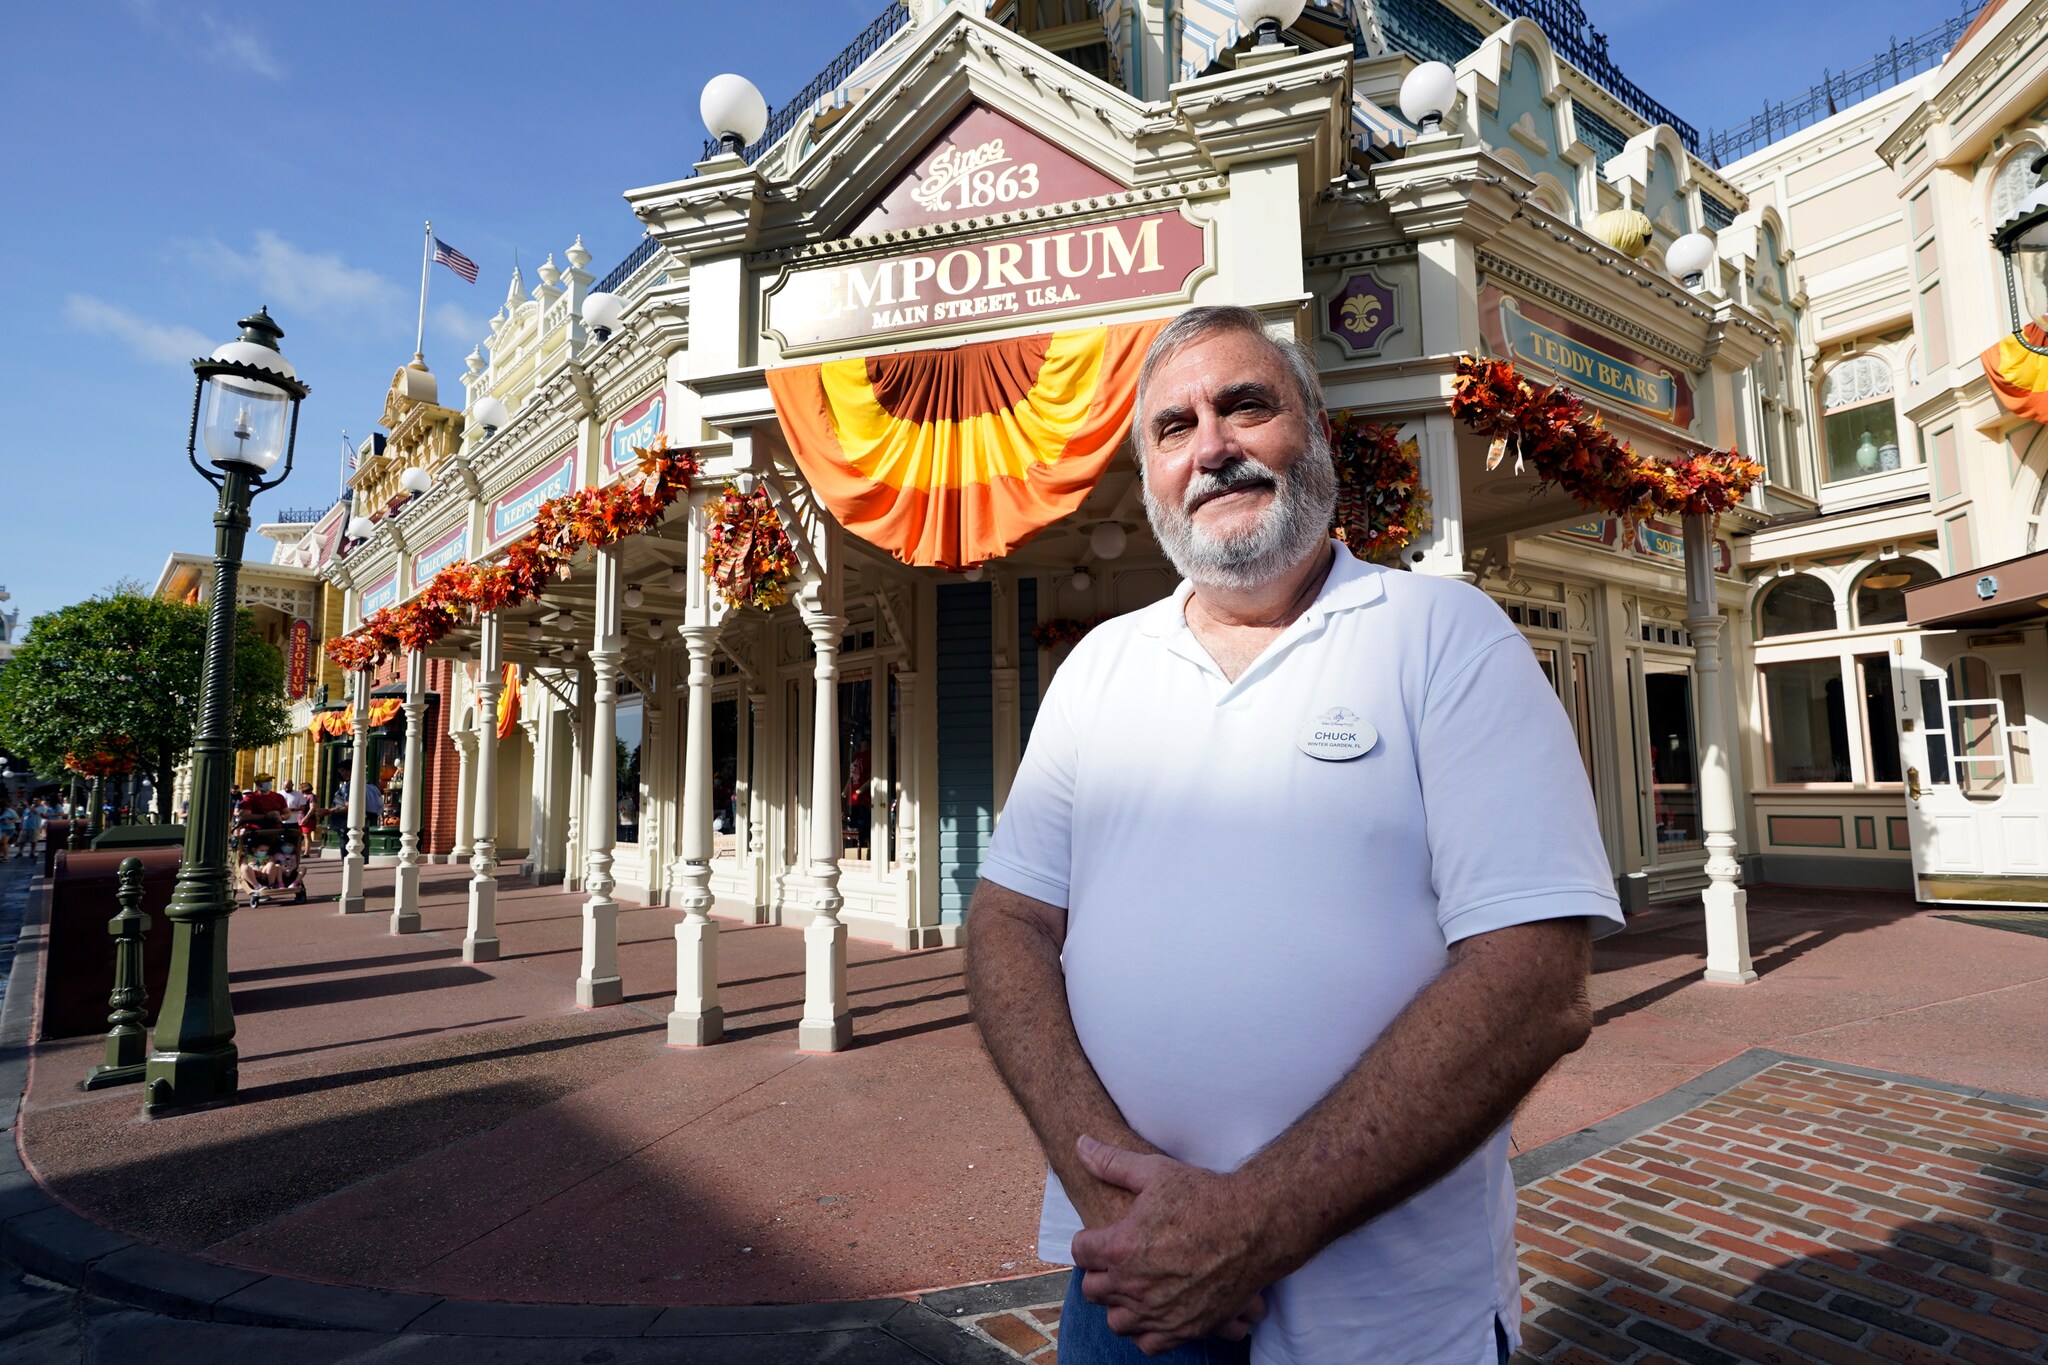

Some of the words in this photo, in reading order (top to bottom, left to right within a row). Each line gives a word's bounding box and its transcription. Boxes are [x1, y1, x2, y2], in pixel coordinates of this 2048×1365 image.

[913, 137, 1012, 192] Since
[956, 163, 1040, 210] 1863
[872, 303, 928, 329] MAIN
[934, 292, 1019, 322] STREET,
[1027, 283, 1081, 307] U.S.A.
[1529, 331, 1594, 378] TEDDY
[1598, 363, 1660, 404] BEARS
[620, 419, 653, 456] TOYS
[504, 477, 561, 527] KEEPSAKES
[420, 539, 463, 577] COLLECTIBLES
[1655, 537, 1682, 556] SOFT
[291, 627, 306, 692] EMPORIUM
[1314, 731, 1357, 741] CHUCK
